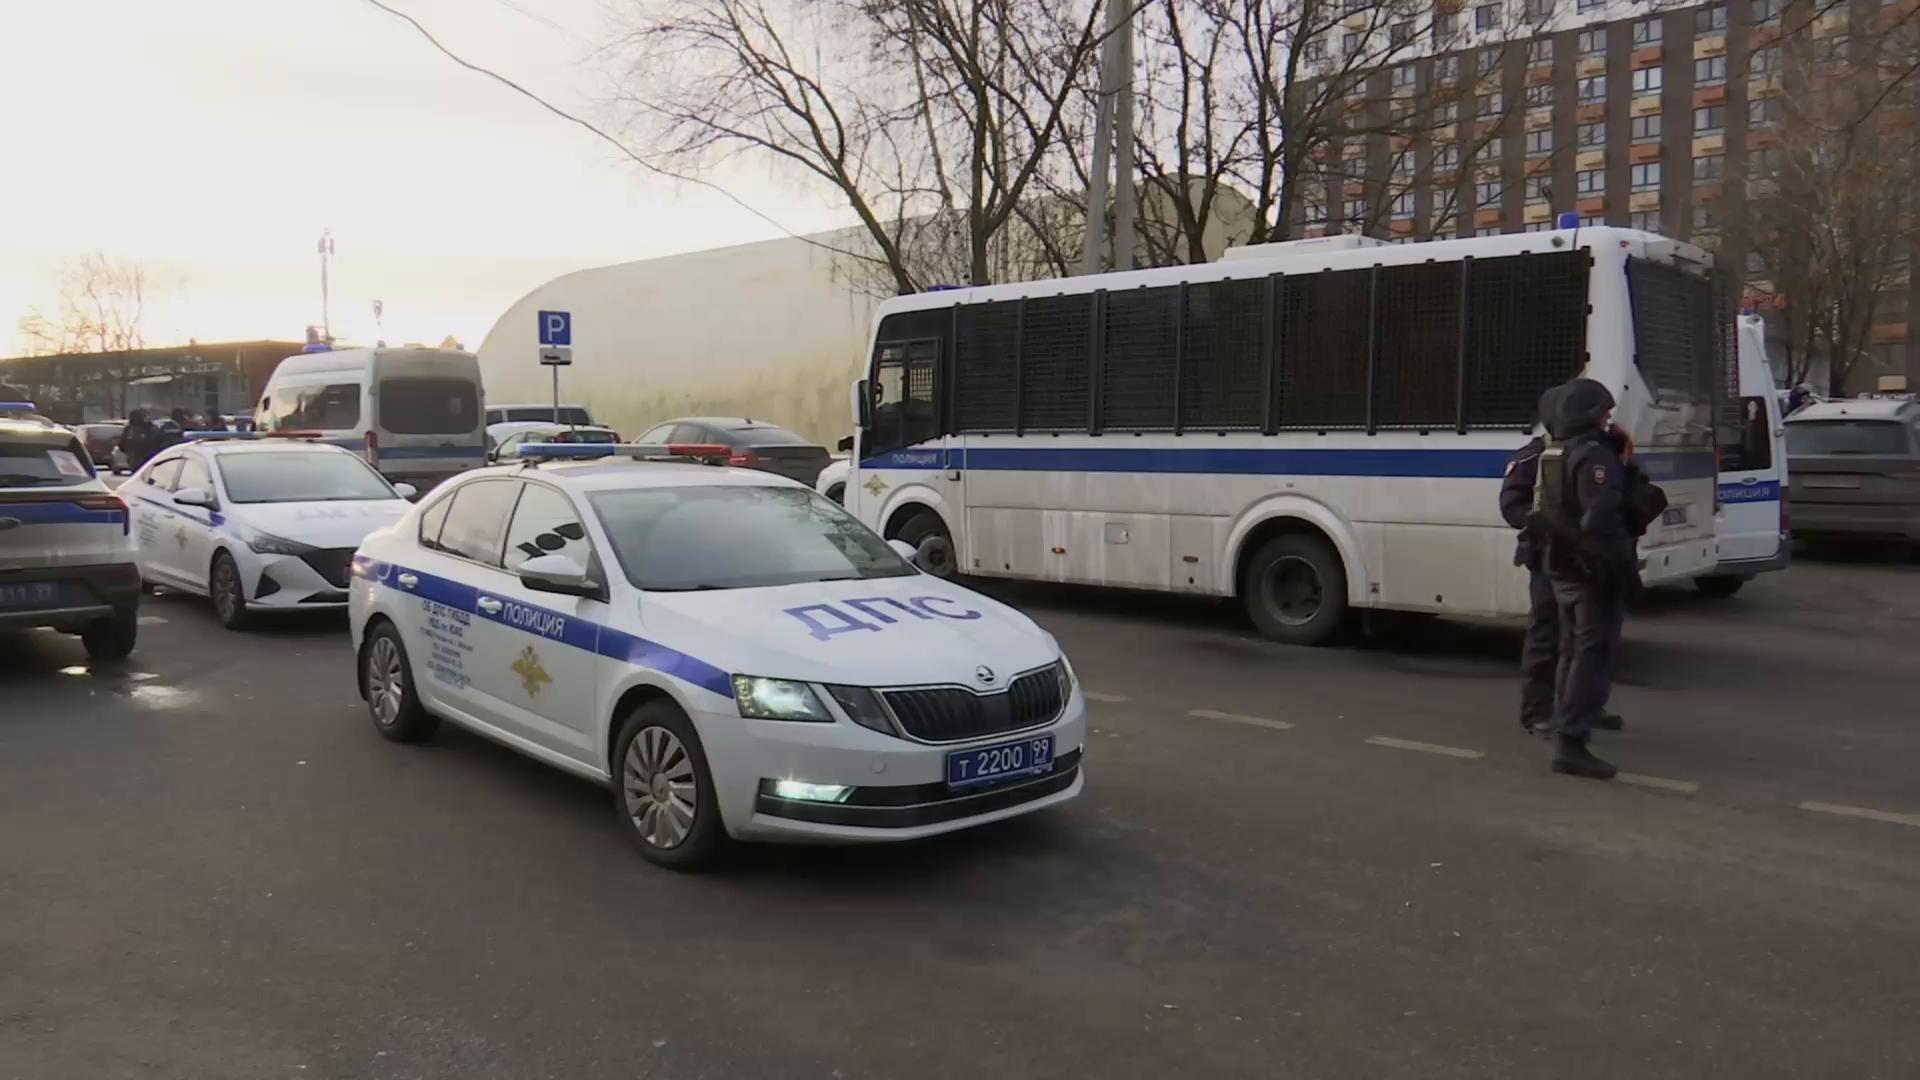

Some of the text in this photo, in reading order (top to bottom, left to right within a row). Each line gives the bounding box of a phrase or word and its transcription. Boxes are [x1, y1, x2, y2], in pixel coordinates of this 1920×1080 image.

[547, 314, 565, 342] P
[1718, 486, 1771, 500] ОЛИЦИЯ
[503, 602, 565, 638] ПОЛИЦИЯ
[783, 596, 983, 642] ДПС
[976, 745, 1023, 776] 2200
[1032, 738, 1049, 758] 99
